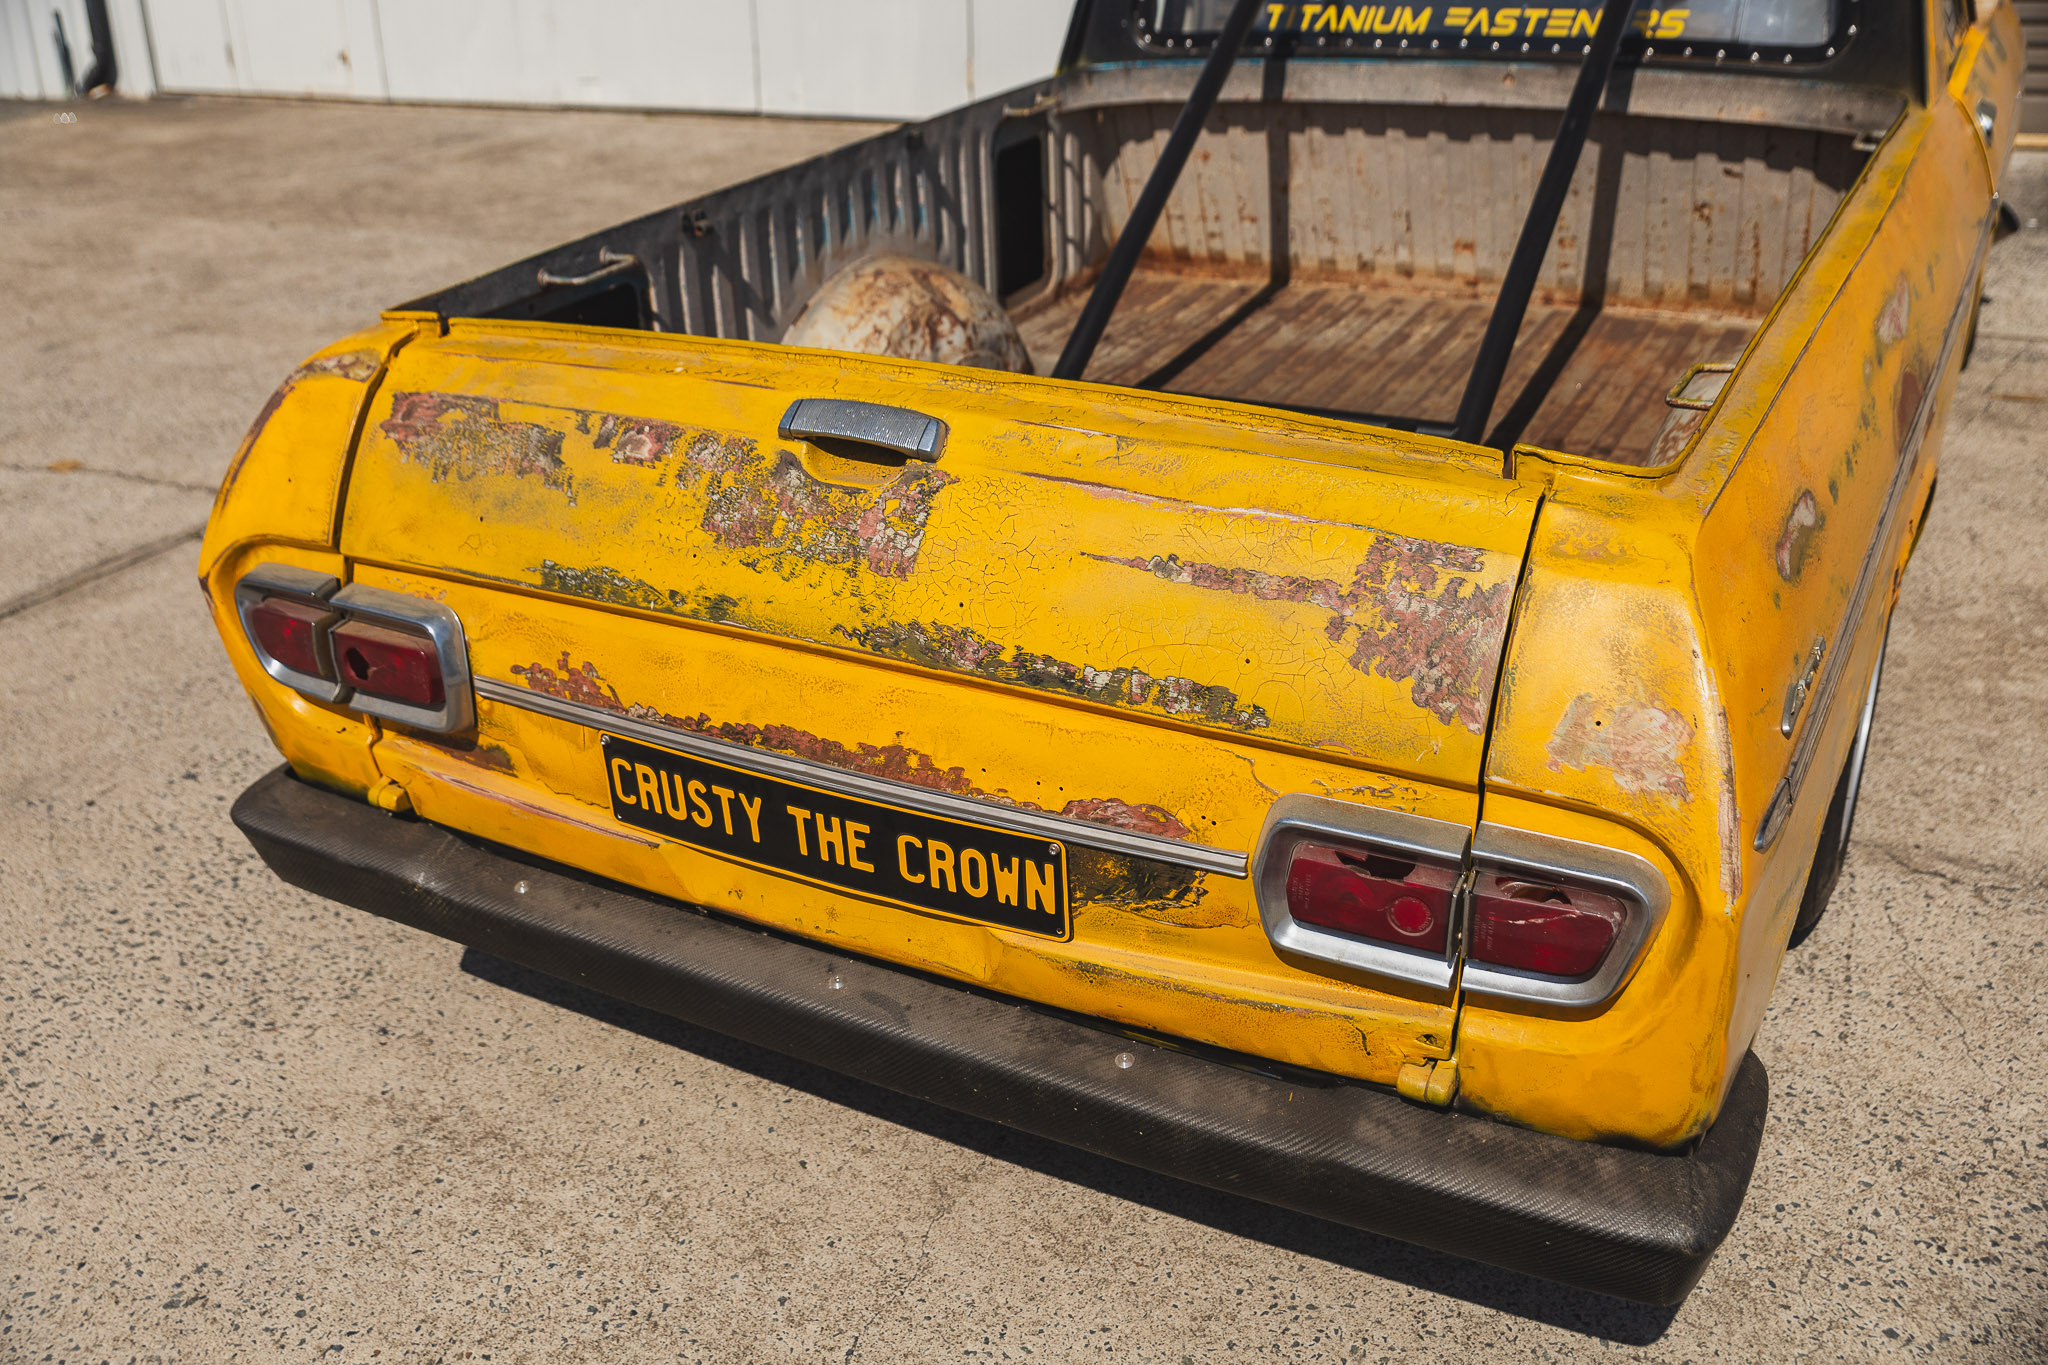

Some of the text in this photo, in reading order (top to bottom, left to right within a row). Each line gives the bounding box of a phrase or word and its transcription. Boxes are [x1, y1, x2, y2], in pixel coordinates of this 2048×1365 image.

[1267, 4, 1690, 38] TITANIUM FASTENRS
[611, 758, 1056, 915] CRUSTY THE CROWN
